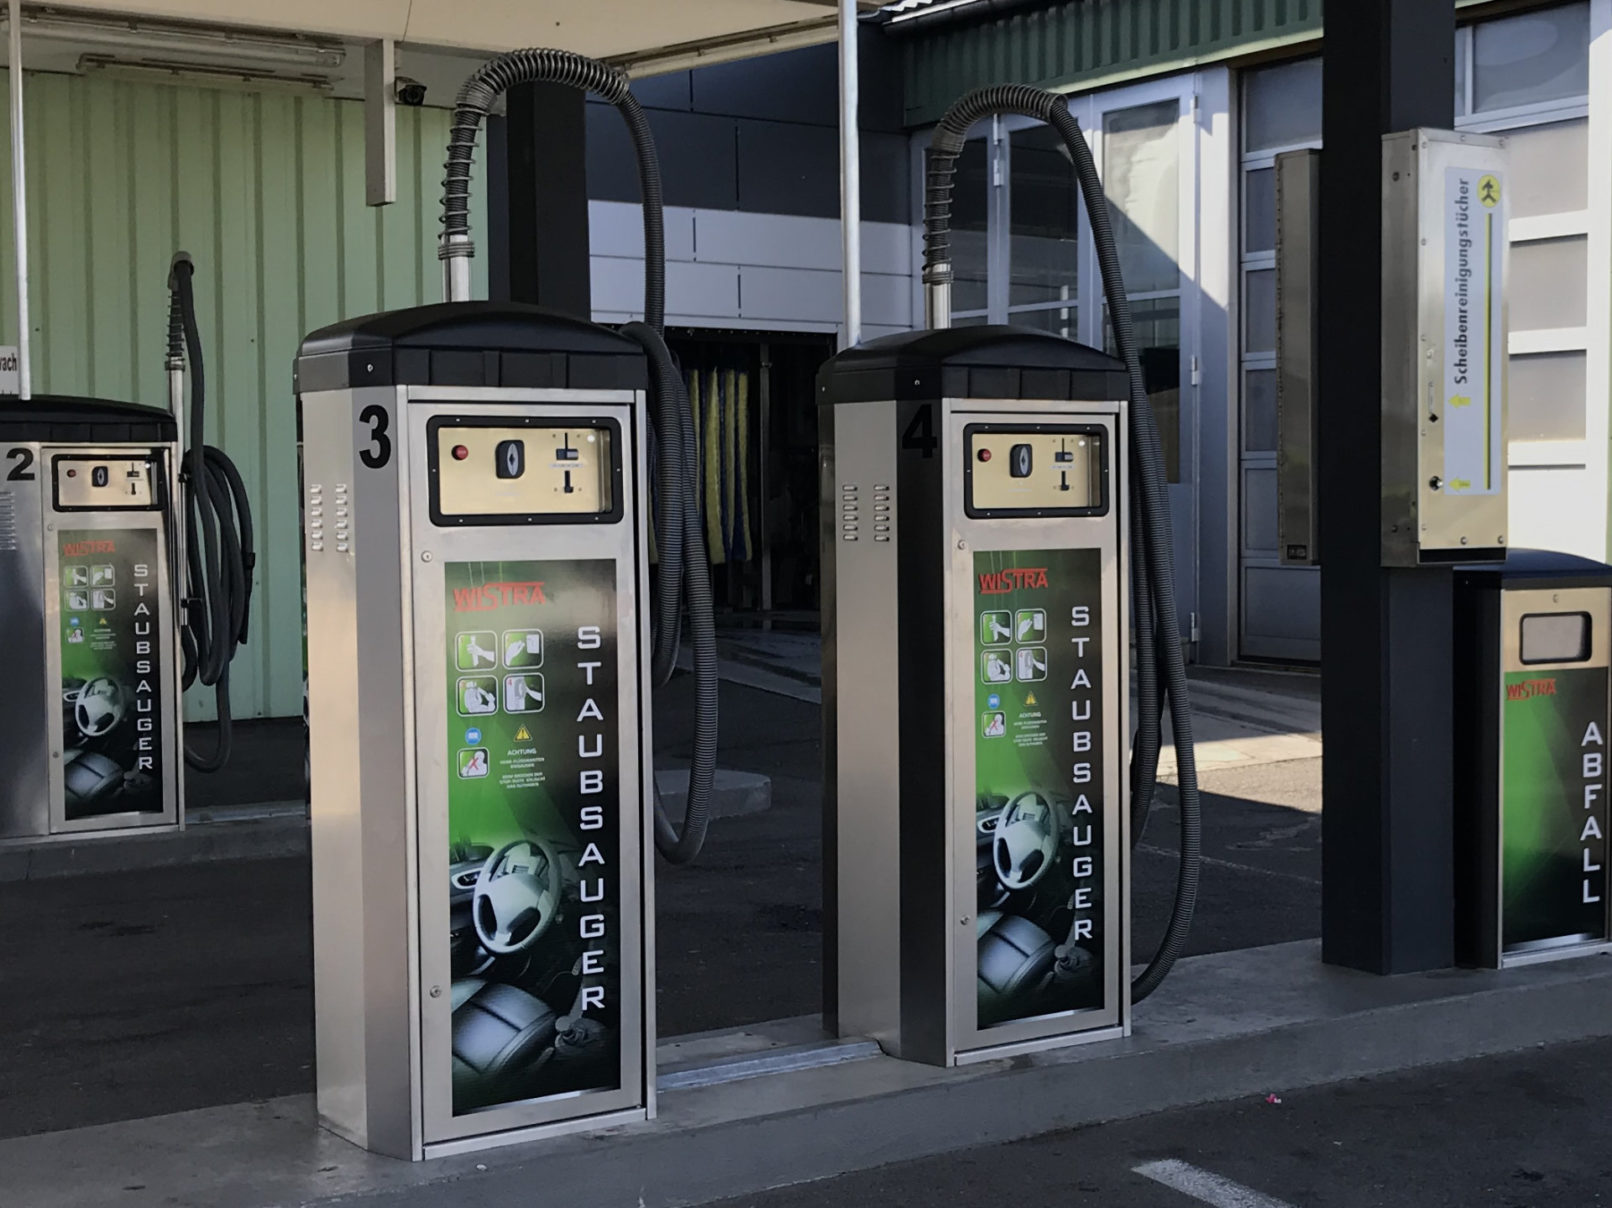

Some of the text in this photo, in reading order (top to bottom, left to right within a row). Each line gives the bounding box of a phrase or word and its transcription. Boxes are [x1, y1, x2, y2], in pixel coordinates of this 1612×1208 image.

[1454, 178, 1472, 385] Scheibenreinigungstücher
[359, 404, 391, 469] 3
[902, 404, 937, 458] 4
[6, 448, 35, 481] 2
[63, 540, 115, 556] WISTRA
[453, 581, 546, 612] WISTRA
[979, 568, 1048, 594] WISTRA
[134, 564, 153, 770] STAUBSAUGER
[1506, 678, 1556, 700] WISTRA
[1070, 606, 1092, 941] STAUBSAUGER
[577, 626, 604, 1011] STAUBSAUGER
[1580, 721, 1603, 903] ABFALL
